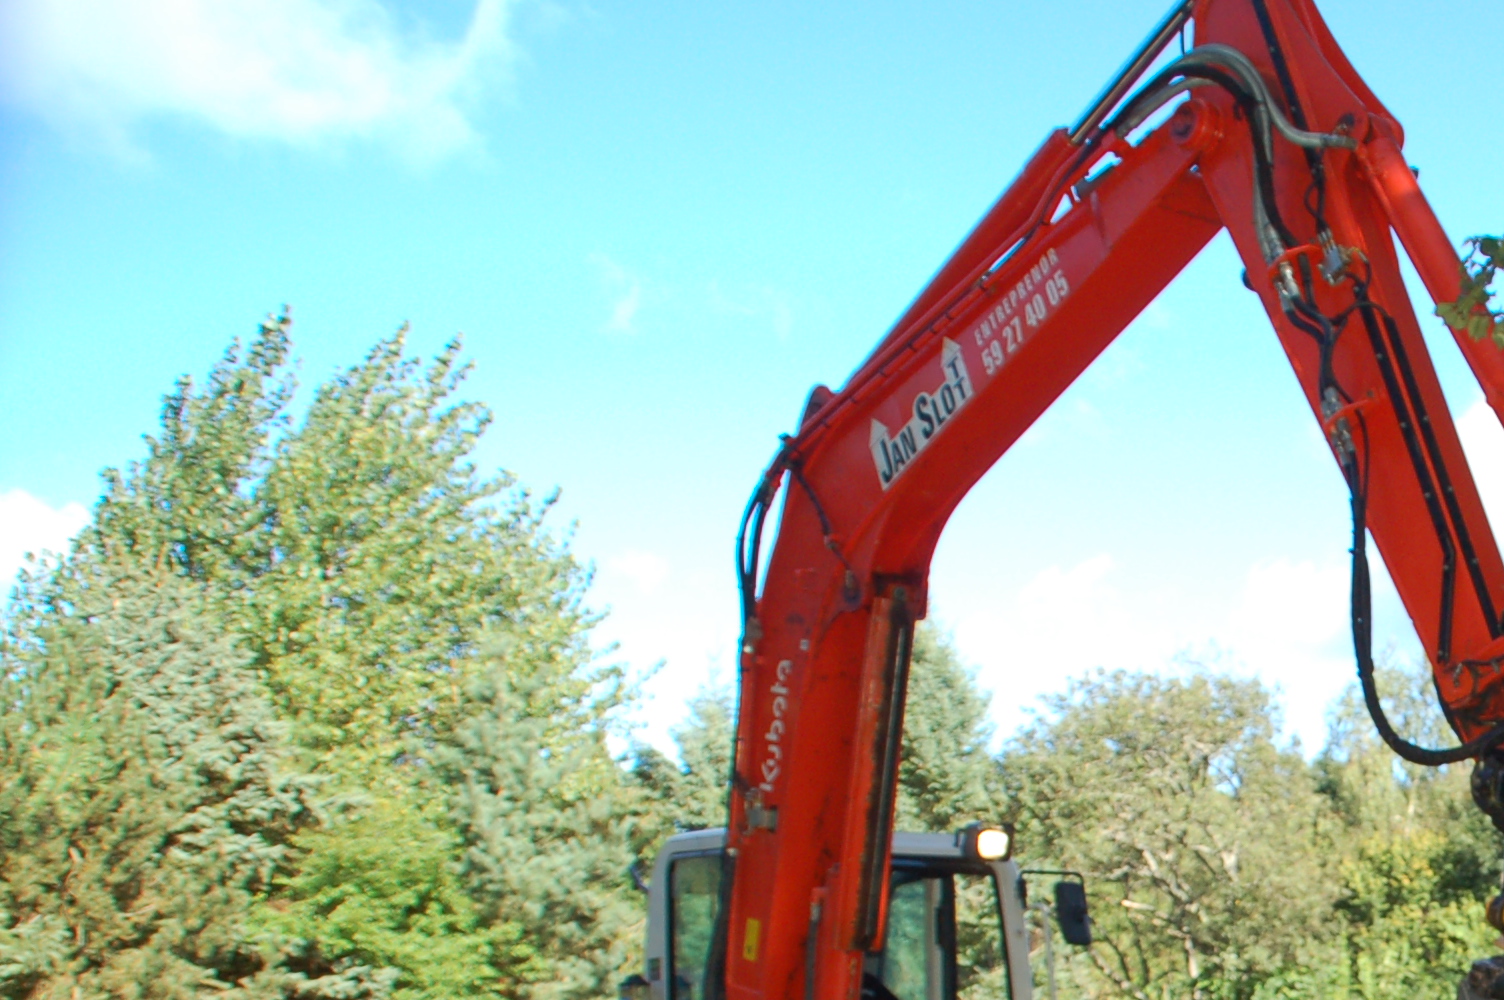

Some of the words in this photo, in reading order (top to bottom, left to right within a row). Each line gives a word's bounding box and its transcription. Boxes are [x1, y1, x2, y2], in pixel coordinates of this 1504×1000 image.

[981, 339, 1005, 375] 59
[1002, 315, 1024, 354] 27
[1025, 293, 1047, 327] 40
[1045, 269, 1070, 306] 05
[759, 662, 792, 791] Kubota
